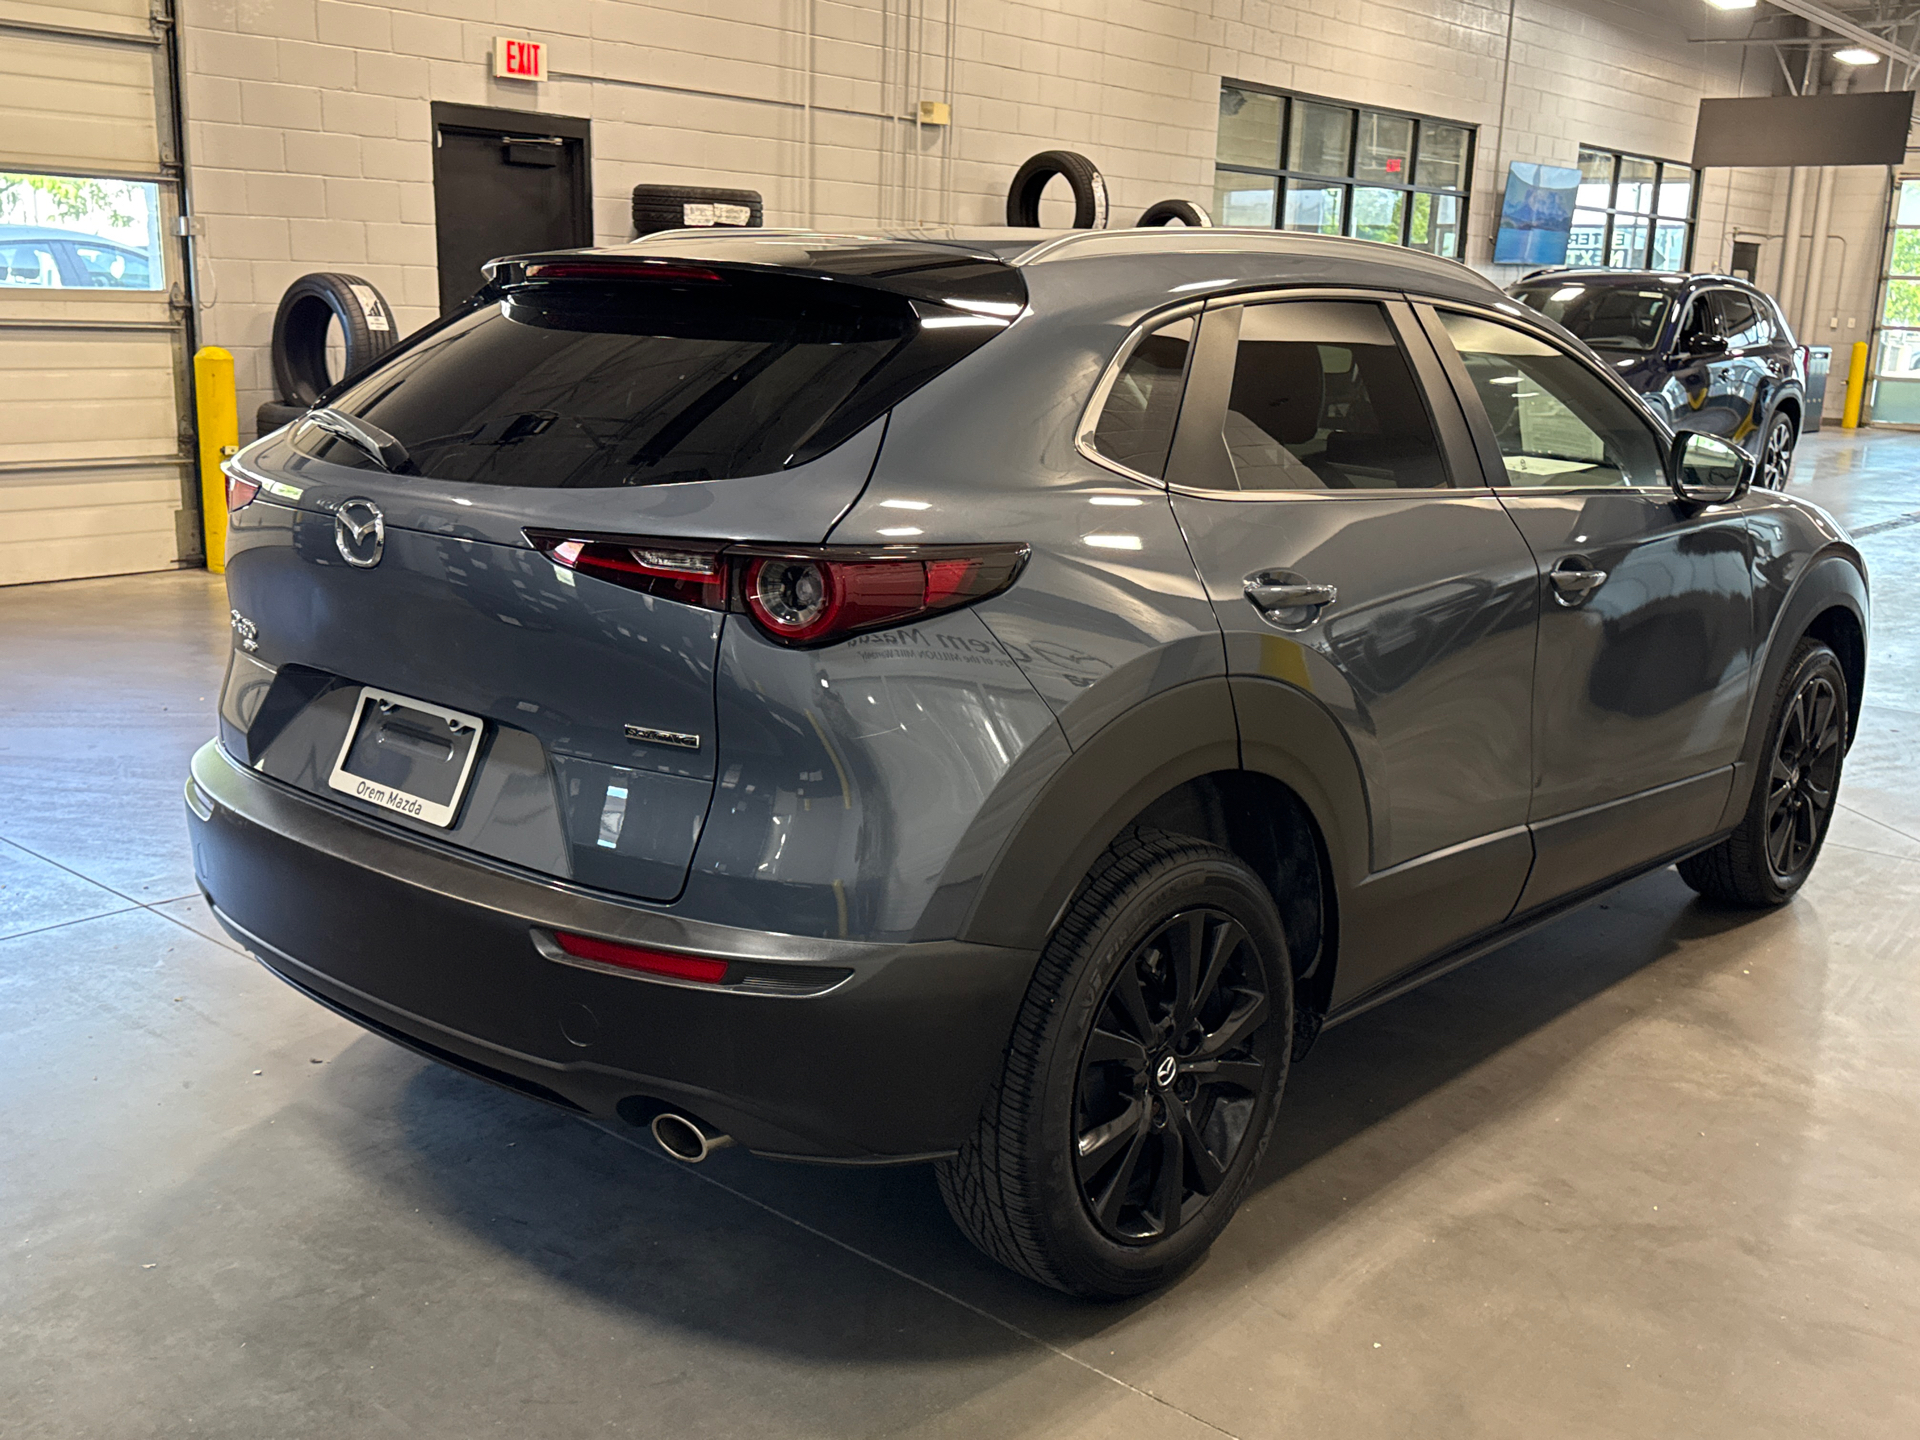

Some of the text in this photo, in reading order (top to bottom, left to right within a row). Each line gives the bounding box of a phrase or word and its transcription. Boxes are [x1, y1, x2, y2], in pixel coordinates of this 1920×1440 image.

[506, 40, 540, 77] EXIT
[356, 781, 423, 815] Orem Mazda
